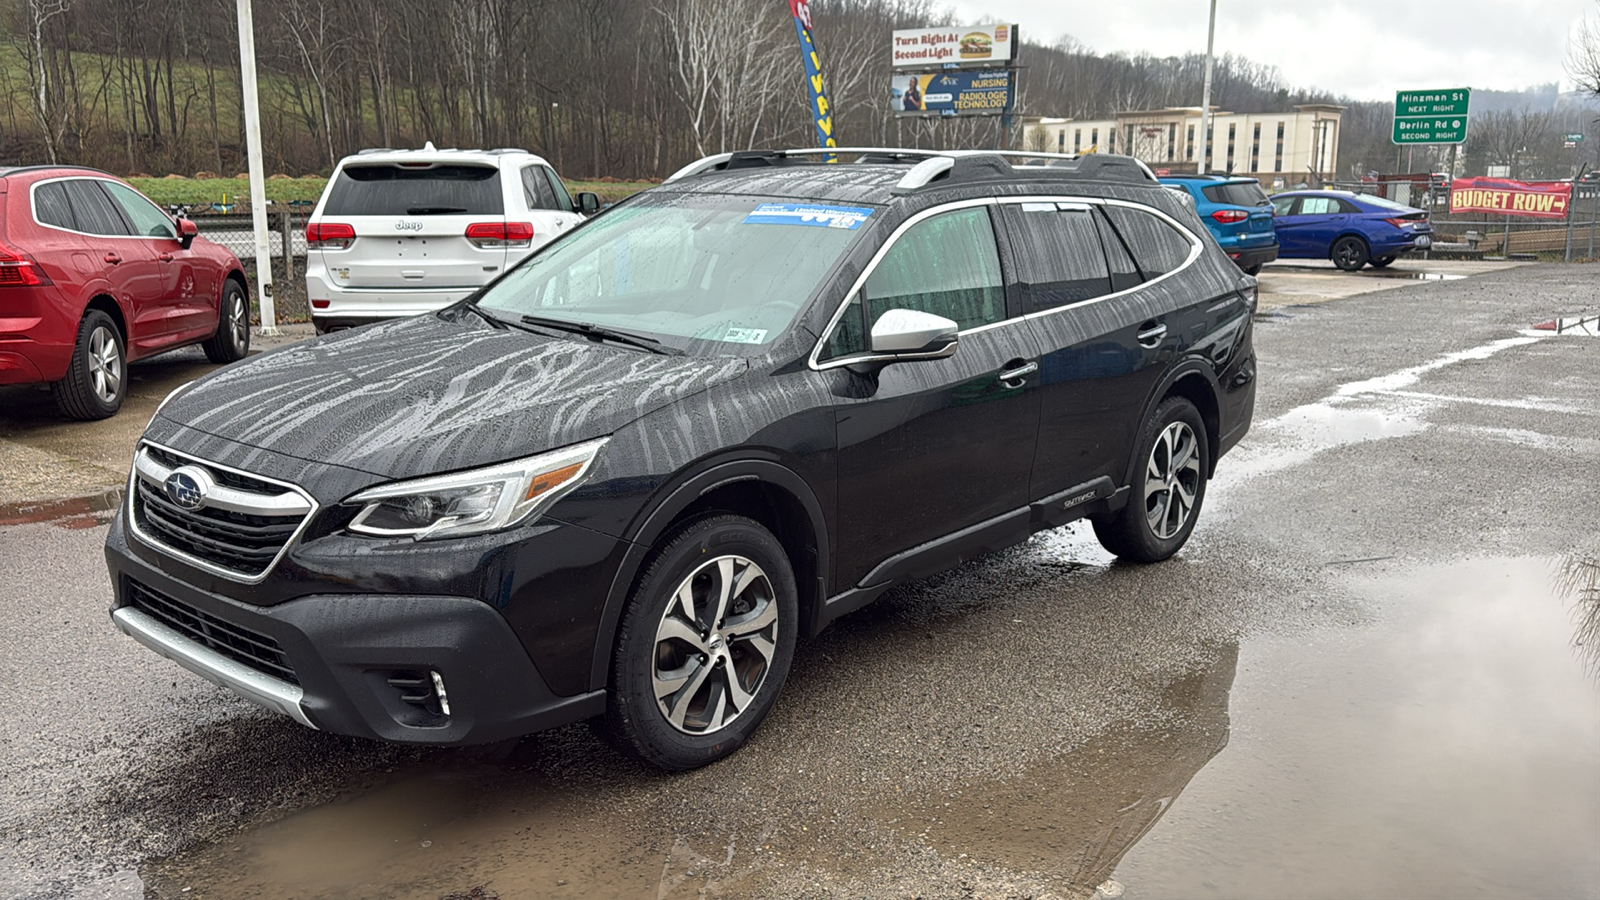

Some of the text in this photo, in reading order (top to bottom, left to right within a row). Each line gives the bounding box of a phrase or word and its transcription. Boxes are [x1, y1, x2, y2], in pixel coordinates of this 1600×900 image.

[895, 33, 958, 46] Turn Right At
[895, 47, 953, 60] Second Light
[971, 78, 1008, 89] NURSING
[959, 91, 1008, 101] RADIOLOGIC
[1401, 92, 1464, 103] Hinzman St
[954, 99, 1007, 109] TECHNOLOGY
[1408, 104, 1455, 113] NEXT RIGHT
[1399, 121, 1430, 130] Berlin
[1435, 120, 1448, 129] Rd
[1401, 132, 1431, 140] SECOND
[1452, 190, 1555, 212] BUDGET ROW
[395, 219, 423, 232] Jeep
